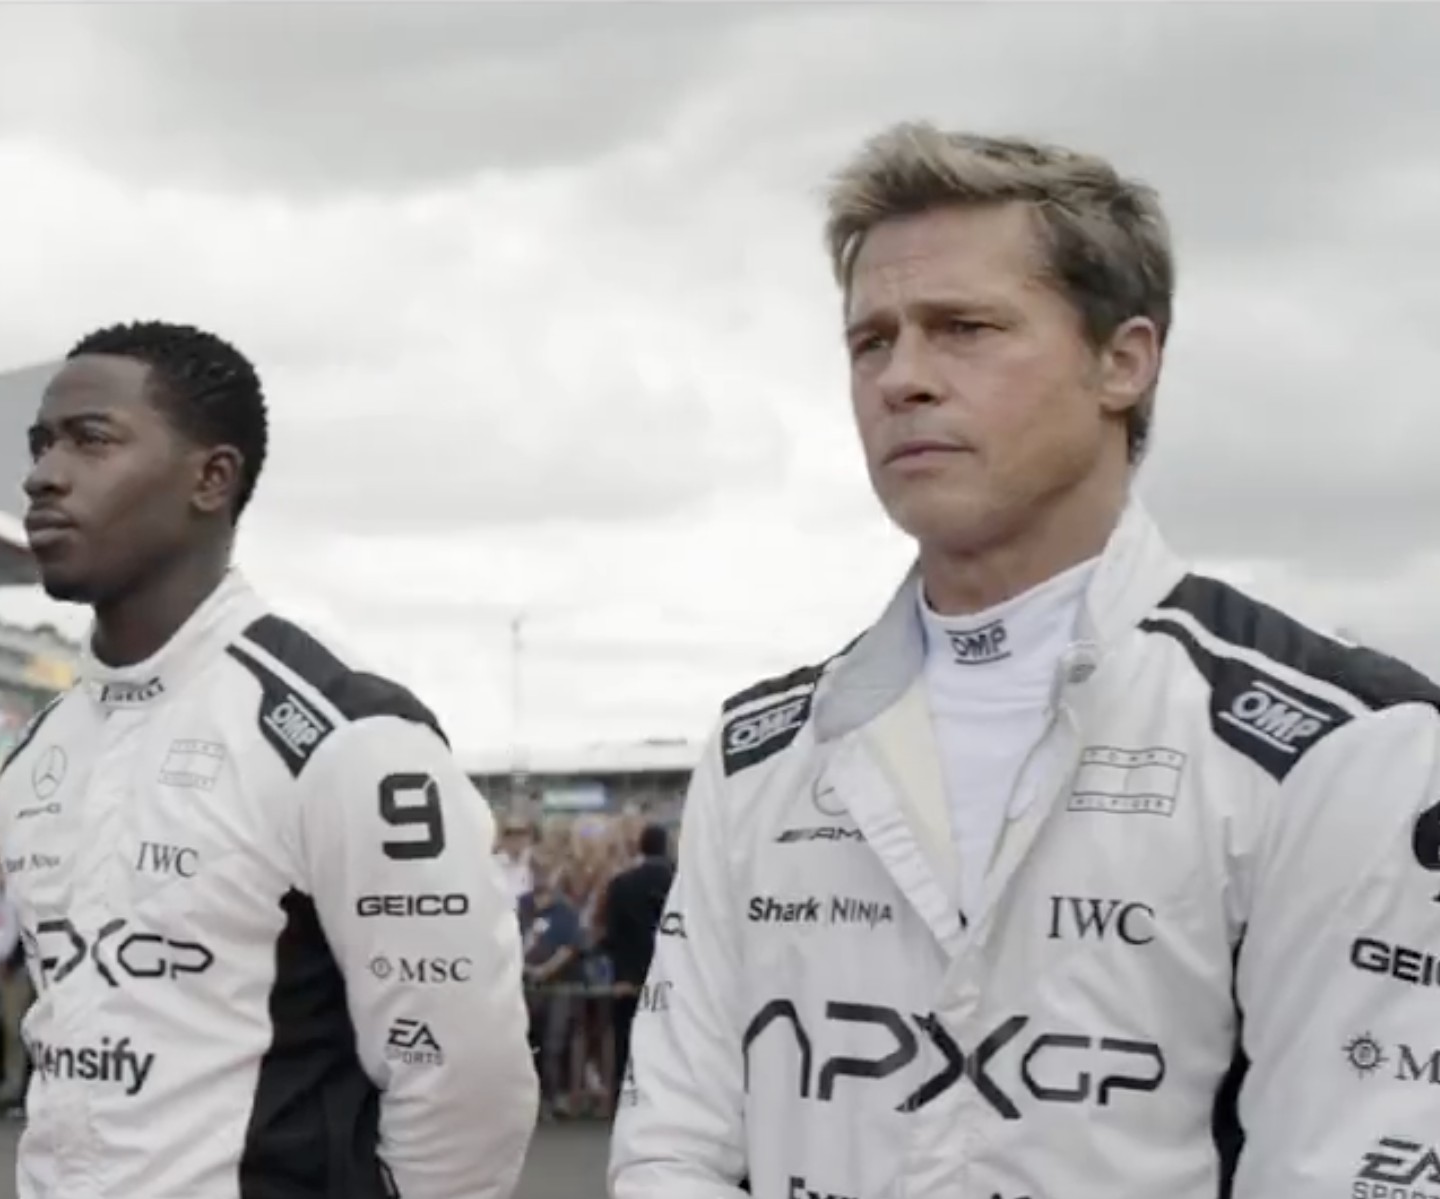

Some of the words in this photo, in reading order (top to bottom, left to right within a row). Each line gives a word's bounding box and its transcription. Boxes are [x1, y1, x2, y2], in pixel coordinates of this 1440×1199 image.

[949, 625, 1007, 657] OMP
[271, 702, 317, 744] OMP
[730, 701, 806, 748] OMP
[1231, 691, 1322, 742] OMP
[378, 773, 445, 860] 9
[136, 841, 200, 879] IWC
[357, 893, 469, 917] GEICO
[748, 896, 820, 923] Shark
[1047, 896, 1156, 945] IWC
[399, 956, 474, 984] MSC
[1350, 937, 1440, 987] GEI
[387, 1018, 441, 1051] EA
